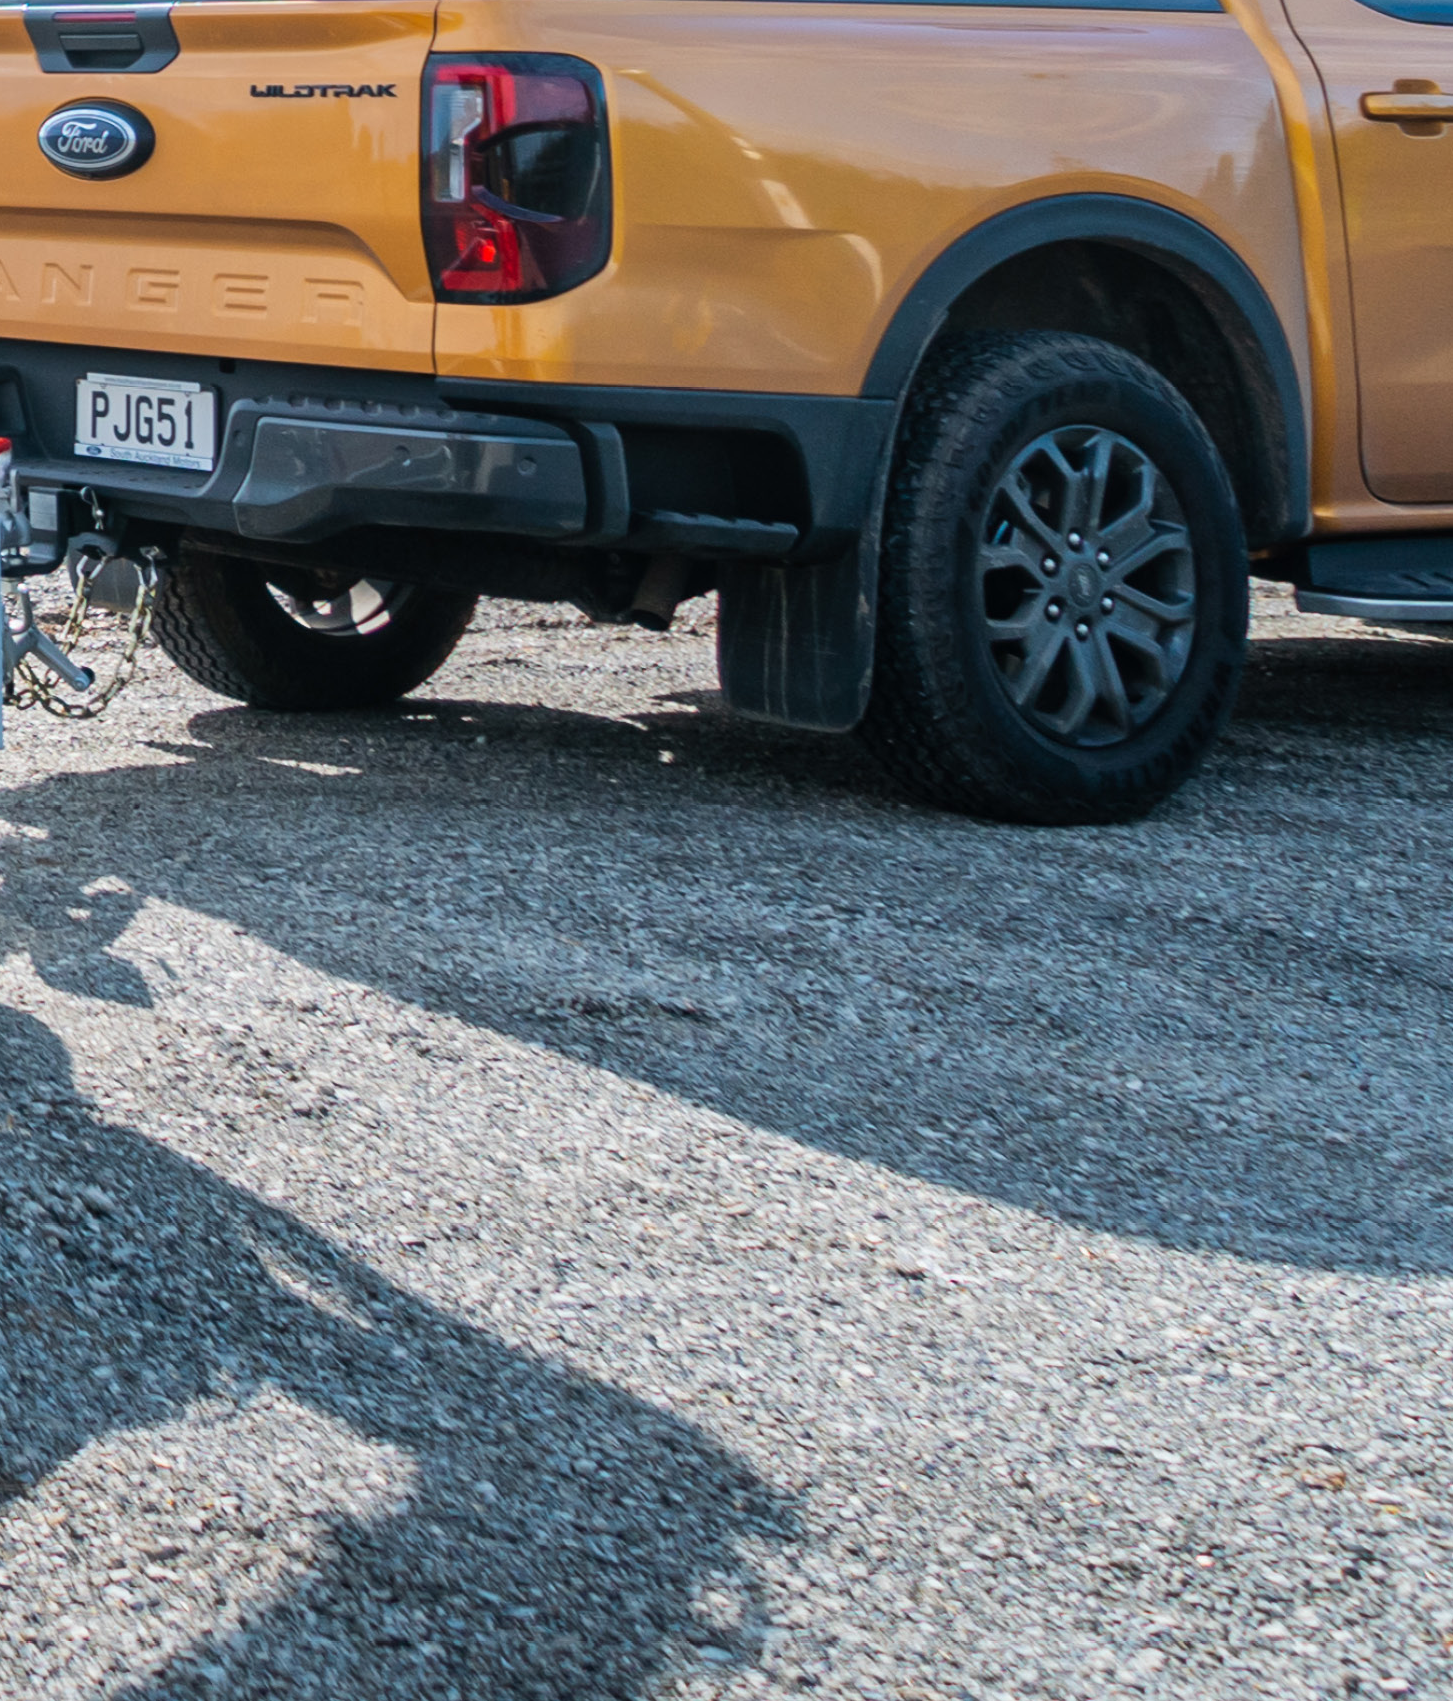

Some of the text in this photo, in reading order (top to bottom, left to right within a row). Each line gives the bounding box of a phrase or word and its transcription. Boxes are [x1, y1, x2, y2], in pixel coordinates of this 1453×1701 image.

[250, 83, 398, 99] WILDTRAK
[57, 121, 109, 155] Ford
[91, 390, 195, 450] PJG51
